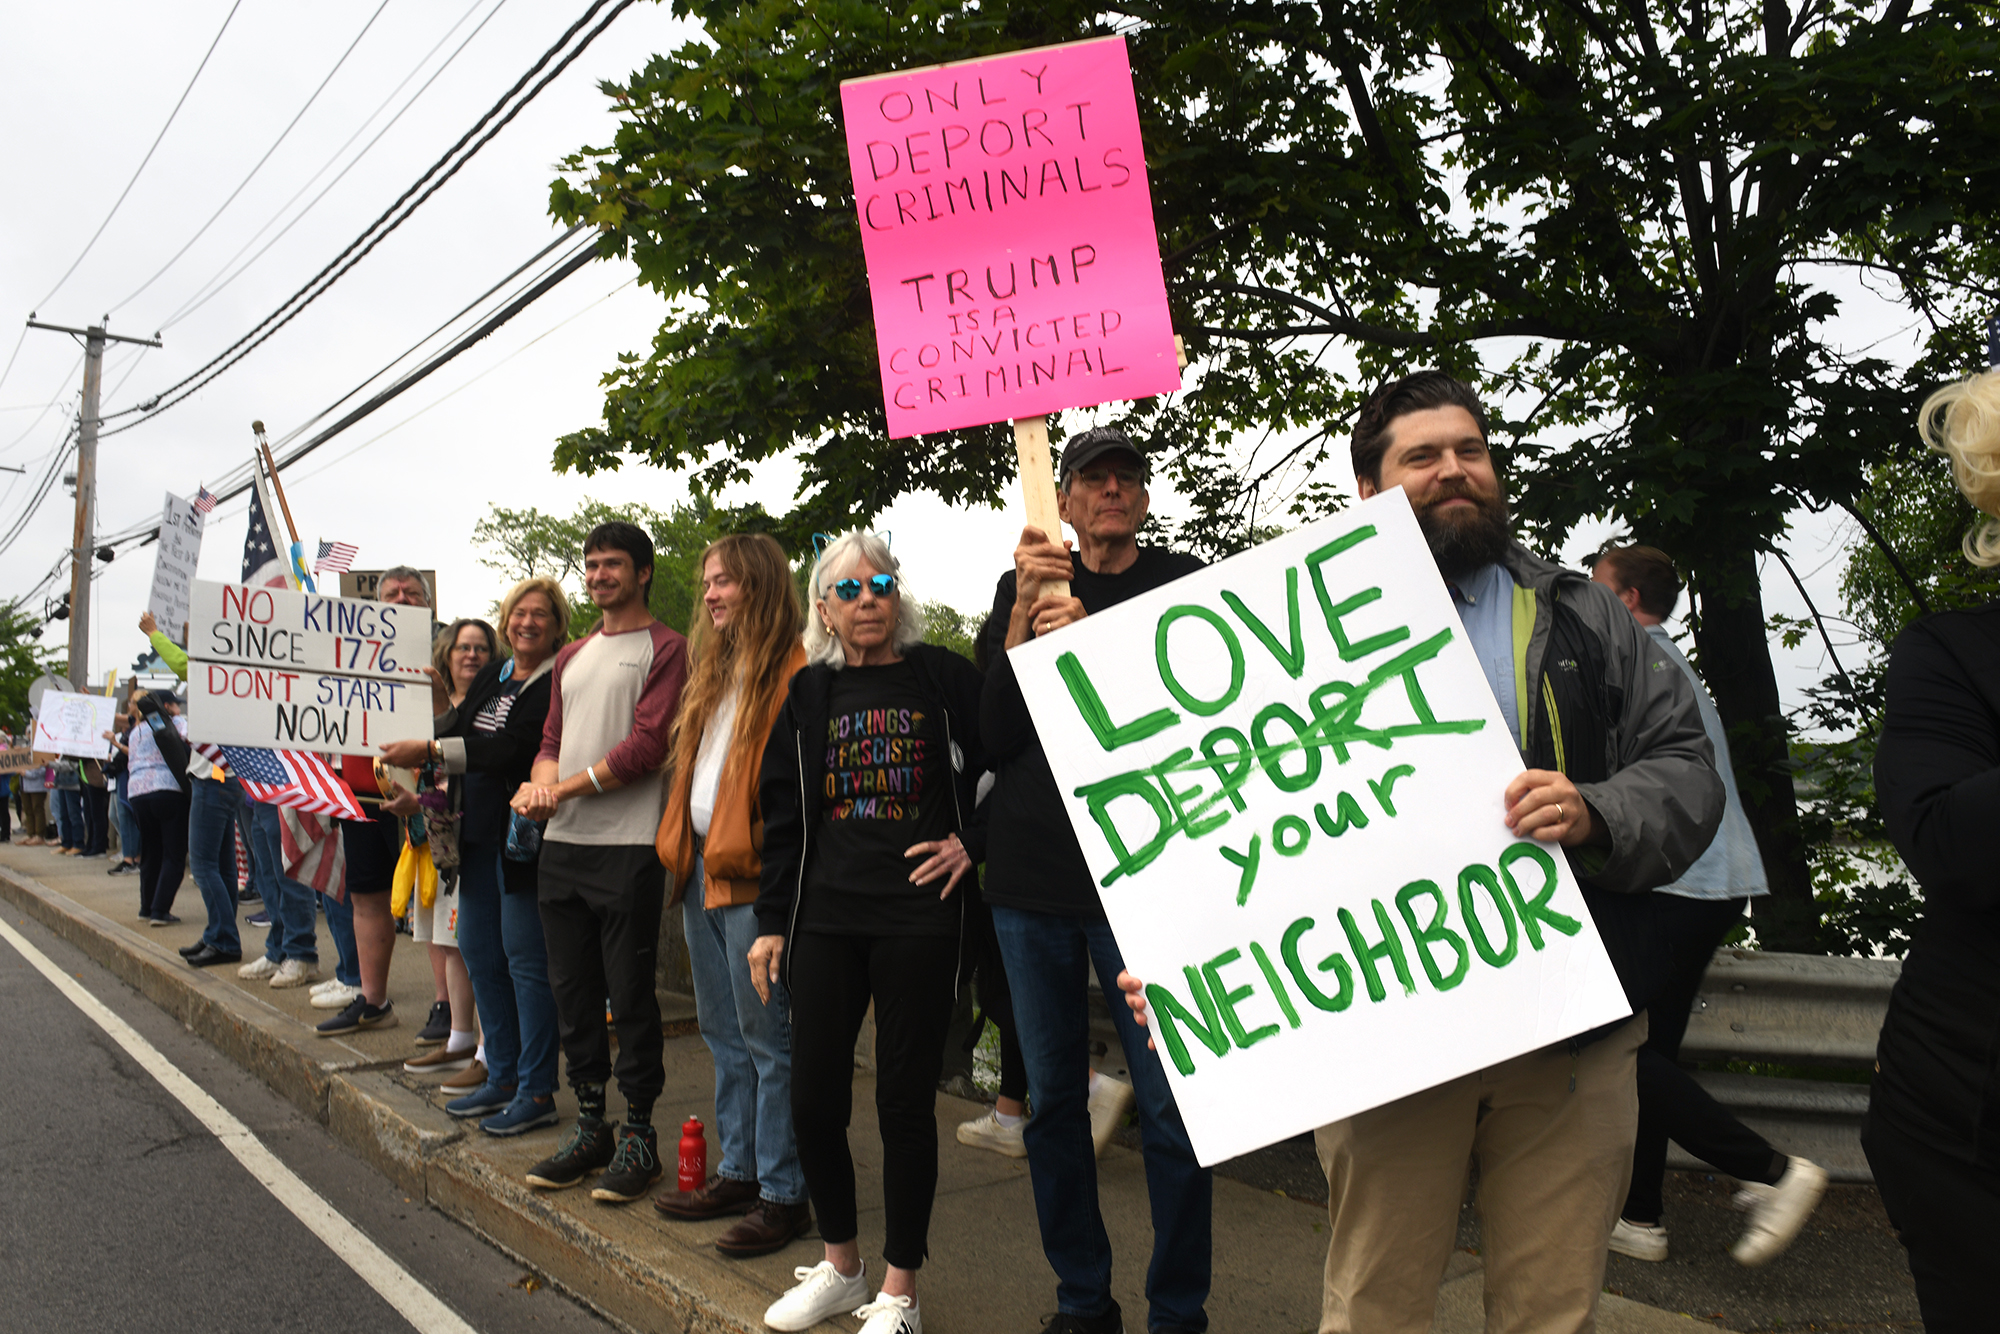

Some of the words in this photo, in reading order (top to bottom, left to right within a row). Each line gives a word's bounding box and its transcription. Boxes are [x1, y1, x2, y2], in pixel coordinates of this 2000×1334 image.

[879, 64, 1048, 122] ONLY
[866, 101, 1091, 181] DEPORT
[865, 147, 1130, 231] CRIMINALS
[901, 244, 1096, 312] TRUMP
[889, 309, 1121, 374] CONVICTED
[949, 309, 980, 336] IS
[992, 305, 1016, 329] A
[893, 347, 1129, 411] CRIMINAL
[211, 621, 305, 664] SINCE
[222, 585, 274, 625] NO
[303, 595, 397, 640] KINGS
[1055, 524, 1411, 751] LOVE
[317, 676, 405, 712] START
[828, 714, 850, 742] NO
[854, 708, 910, 736] KINGS
[839, 737, 925, 768] FASCISTS
[840, 766, 923, 795] TYRANTS
[1074, 628, 1486, 886] DEPORT
[852, 796, 903, 821] NAZIS
[1219, 764, 1415, 906] your
[1145, 841, 1583, 1076] NEIGHBOR
